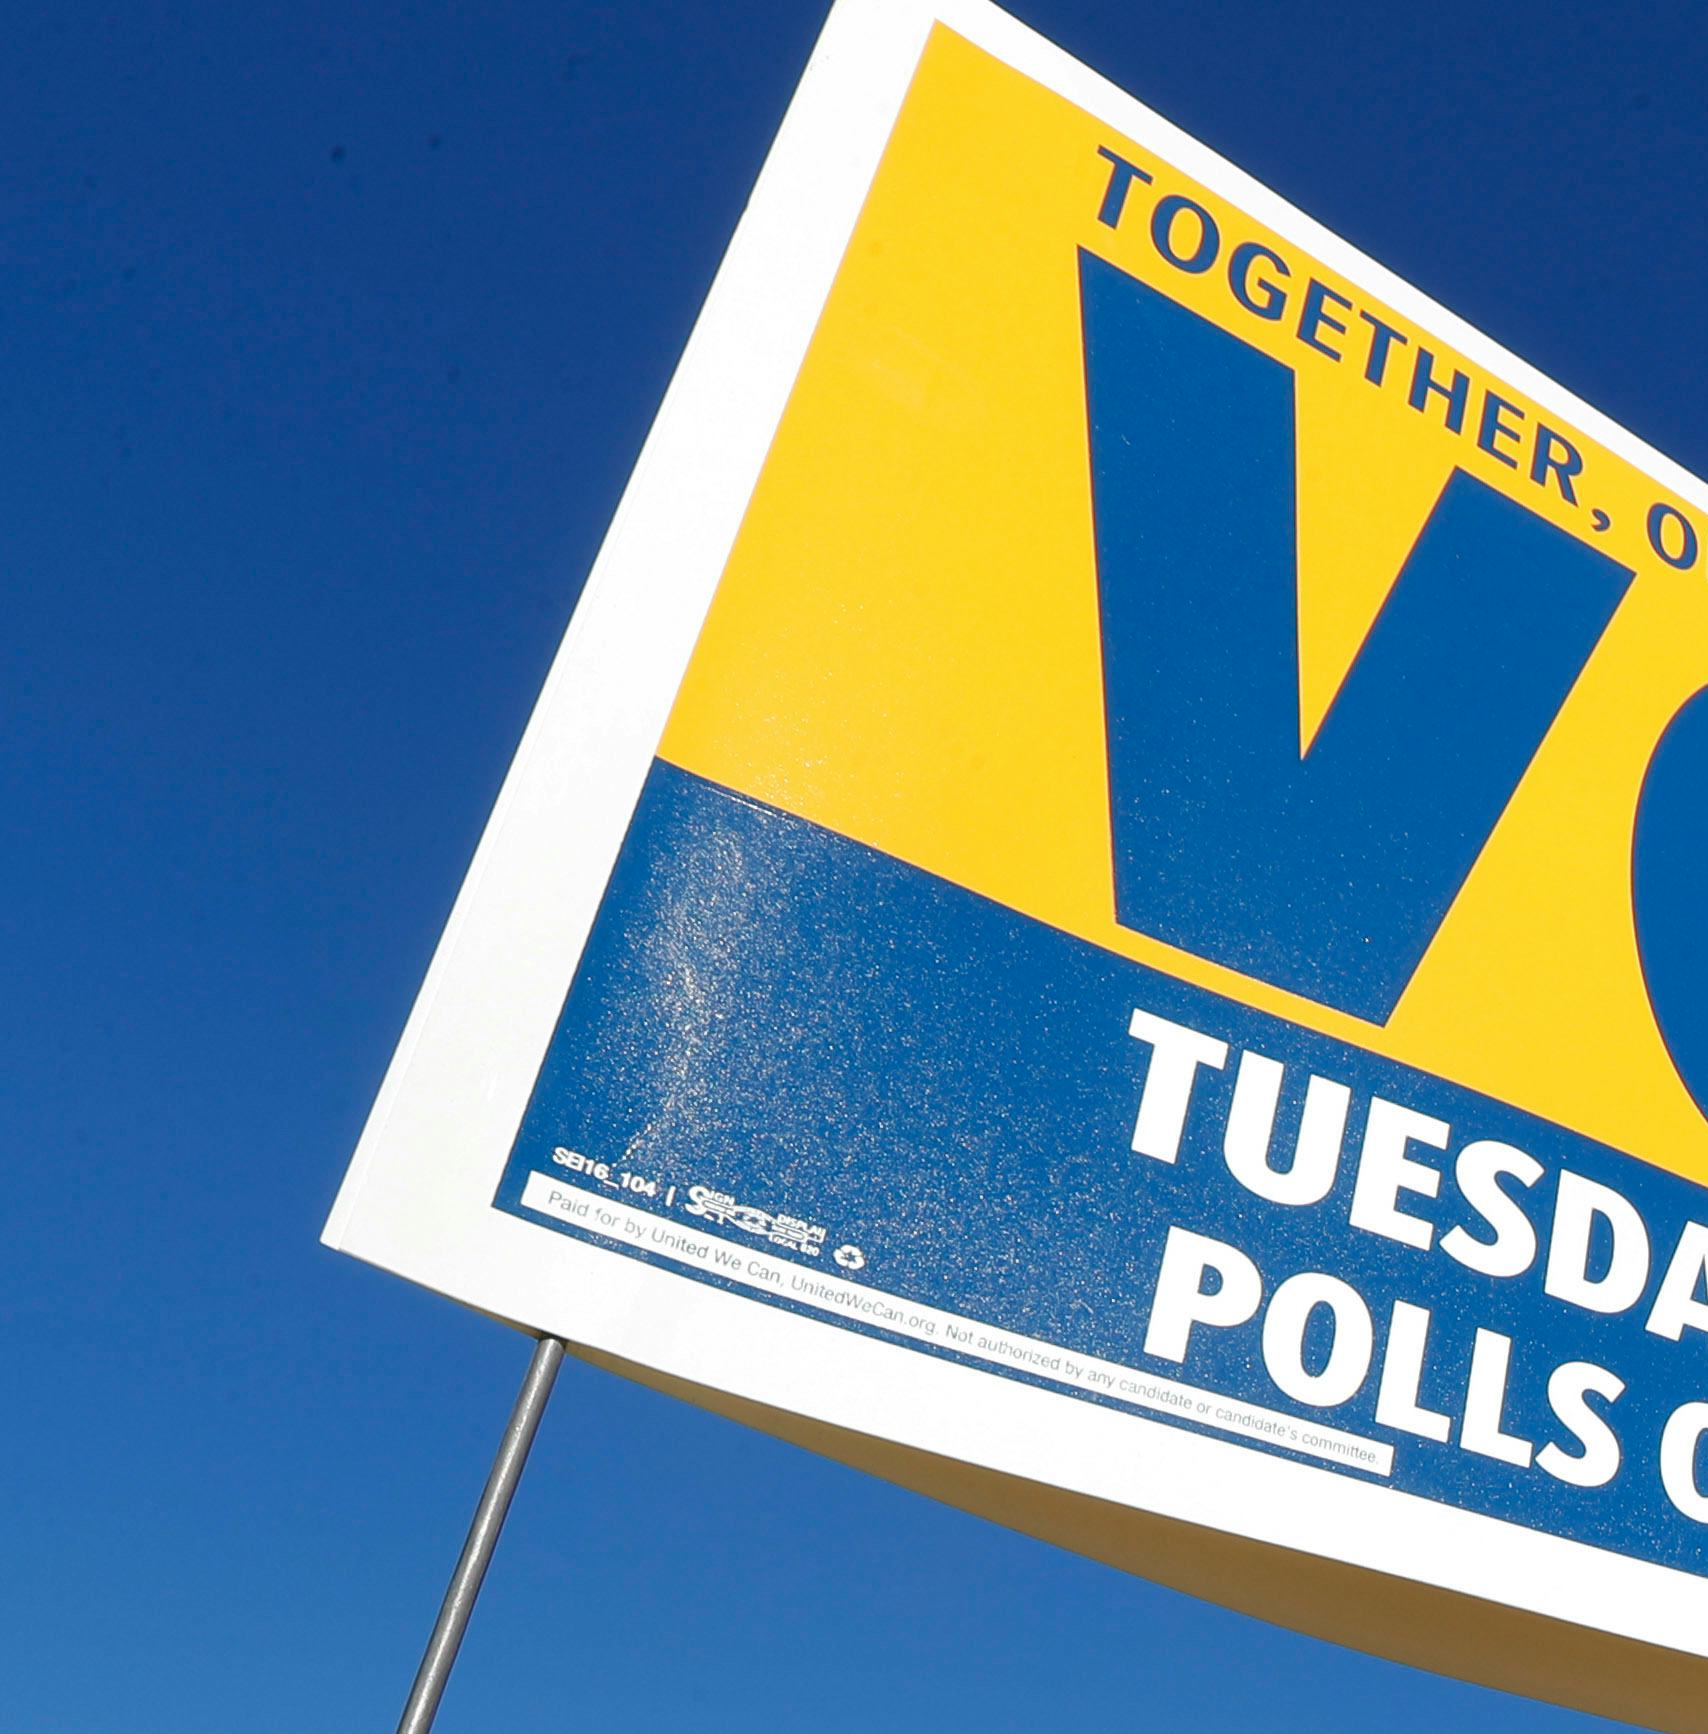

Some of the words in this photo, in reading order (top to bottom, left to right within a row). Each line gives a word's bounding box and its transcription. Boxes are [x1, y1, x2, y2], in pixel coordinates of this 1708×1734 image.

[1096, 145, 1612, 533] TOGETHER,
[548, 1190, 590, 1217] Paid
[595, 1207, 620, 1227] for
[624, 1217, 647, 1238] by
[651, 1229, 709, 1259] United
[715, 1248, 742, 1270] We
[747, 1260, 784, 1288] Can,
[790, 1274, 939, 1336] UnitedWeCan.org.
[945, 1323, 973, 1345] Not
[977, 1335, 1060, 1371] authorized
[1065, 1361, 1084, 1379] by
[1088, 1370, 1115, 1388] any
[1119, 1378, 1193, 1410] candidate
[1196, 1400, 1211, 1414] or
[1301, 1431, 1379, 1465] committee.
[1142, 1225, 1626, 1490] POLLS
